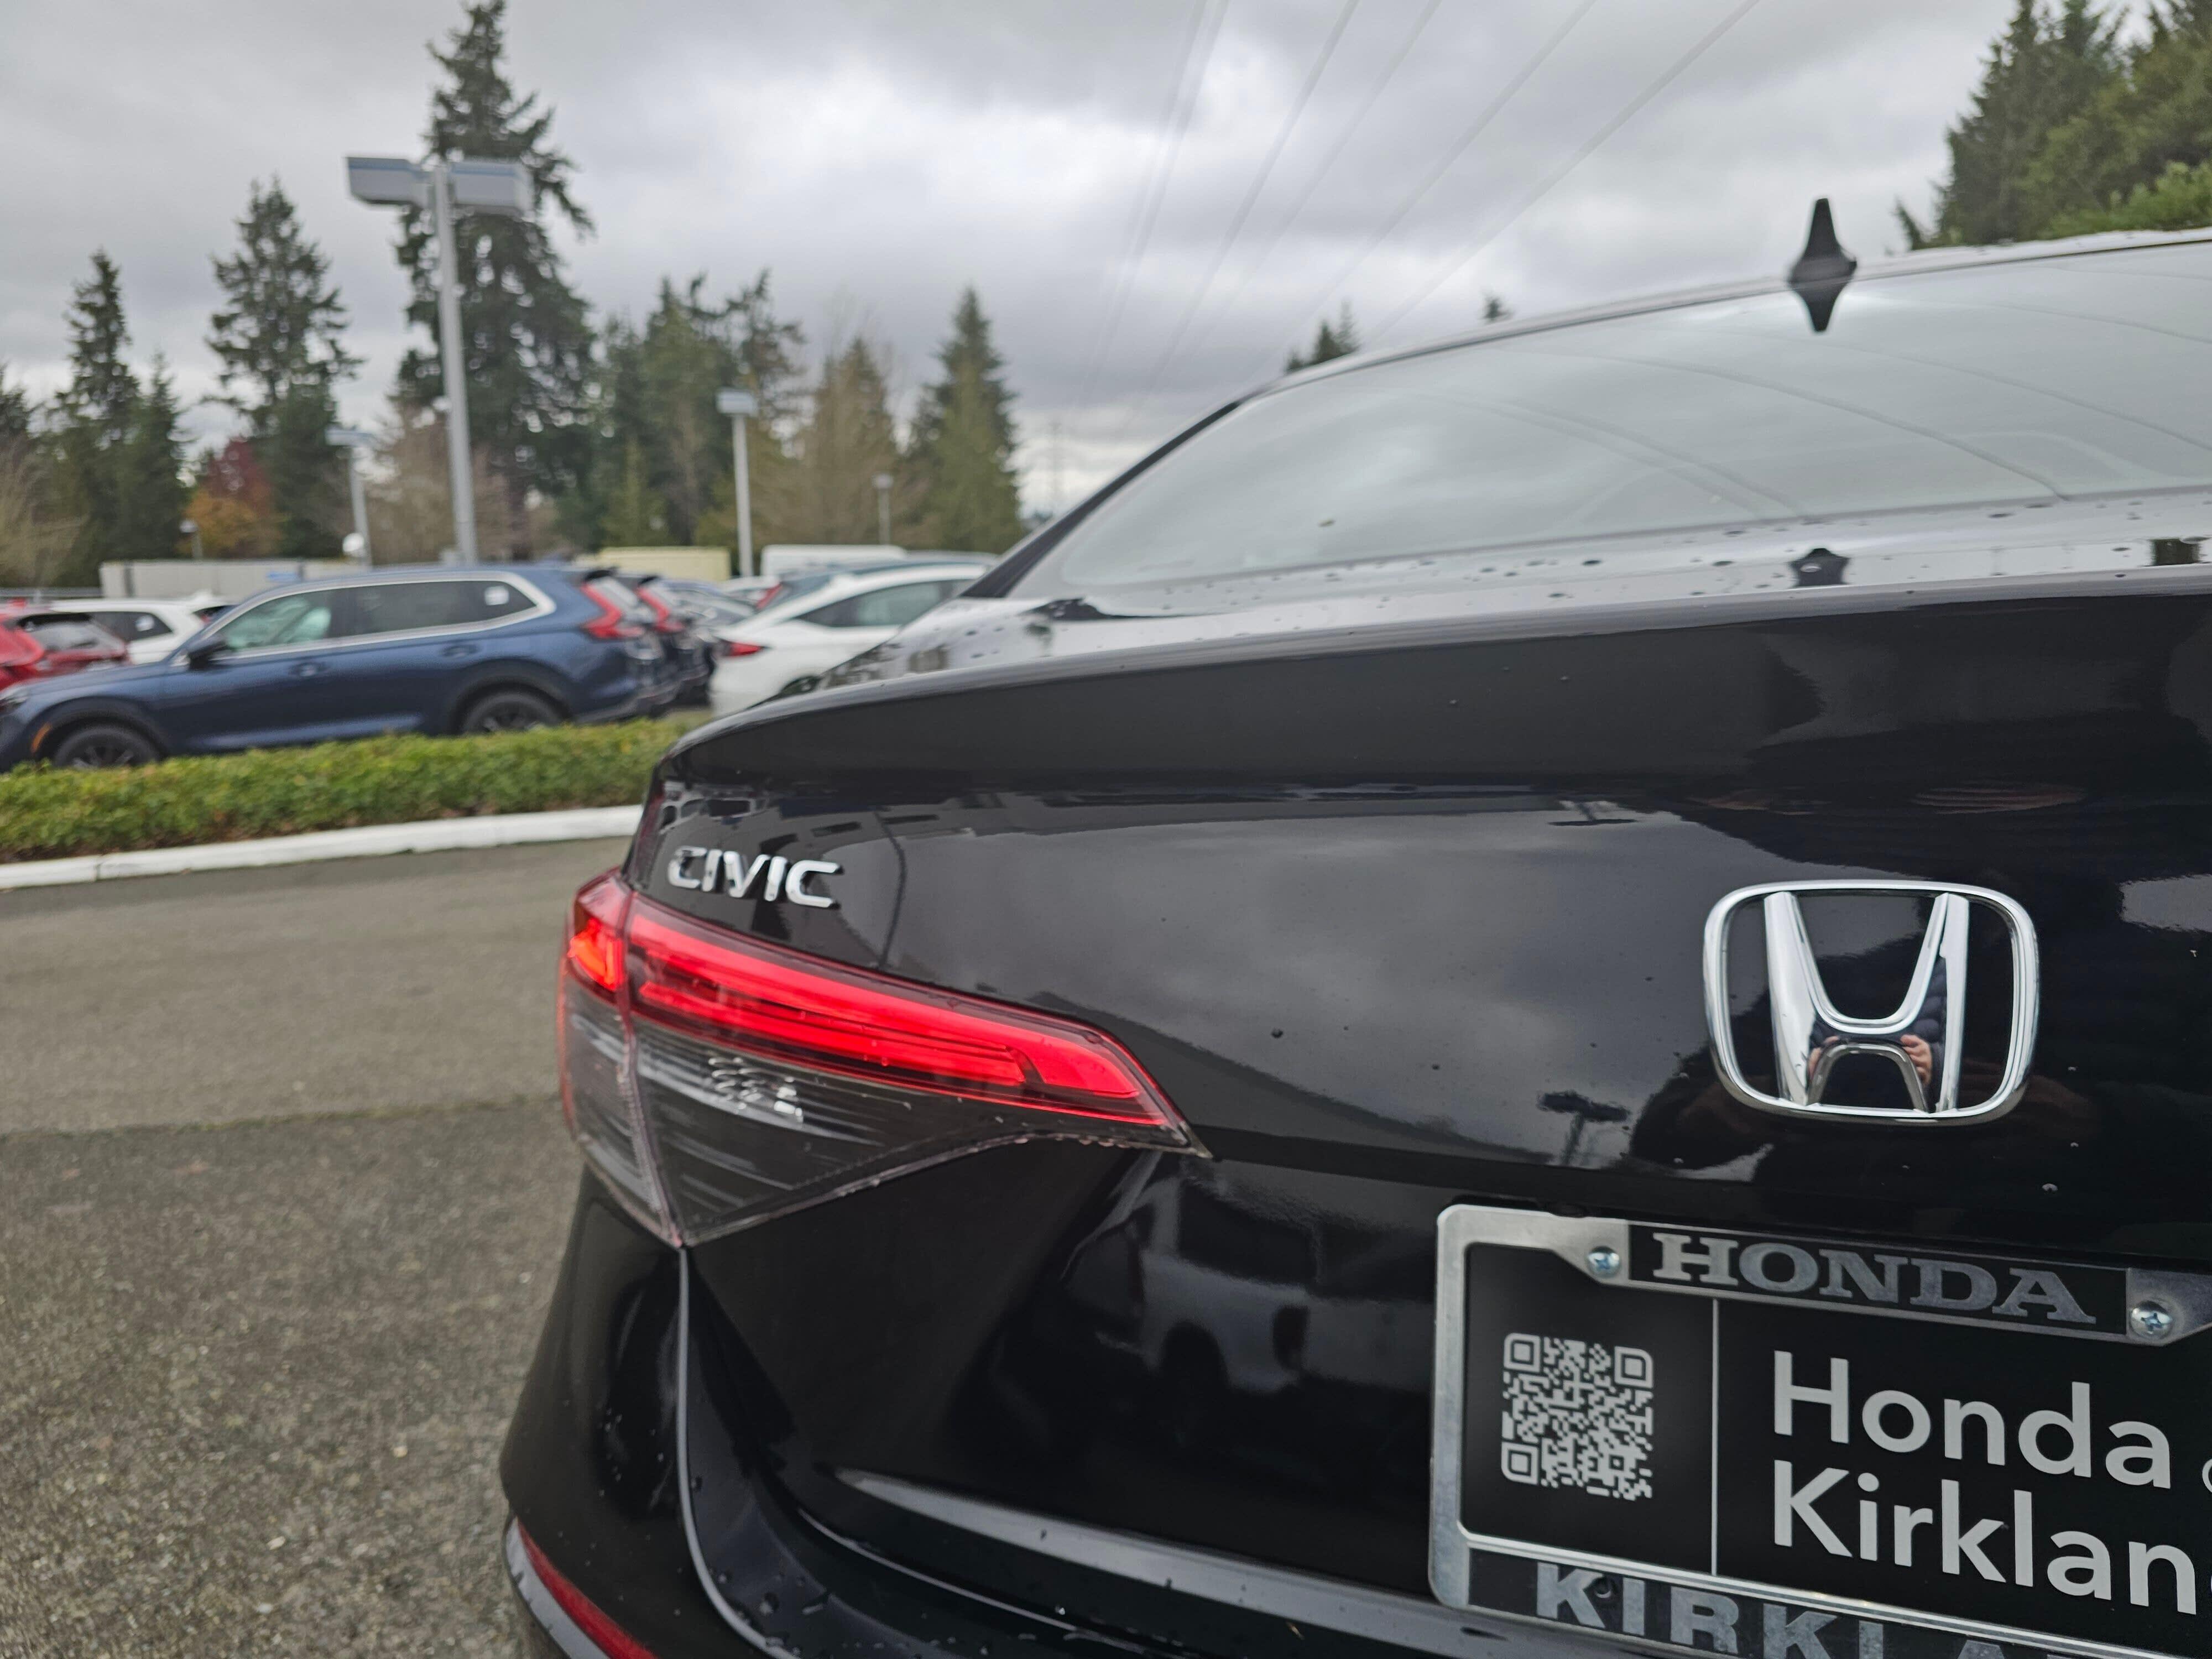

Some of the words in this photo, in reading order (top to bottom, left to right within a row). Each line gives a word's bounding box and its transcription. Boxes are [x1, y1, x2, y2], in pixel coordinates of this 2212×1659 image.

[667, 846, 841, 908] CIVIC
[1652, 1232, 2096, 1324] HONDA
[1773, 1351, 2171, 1489] Honda
[1773, 1459, 2212, 1615] Kirklan
